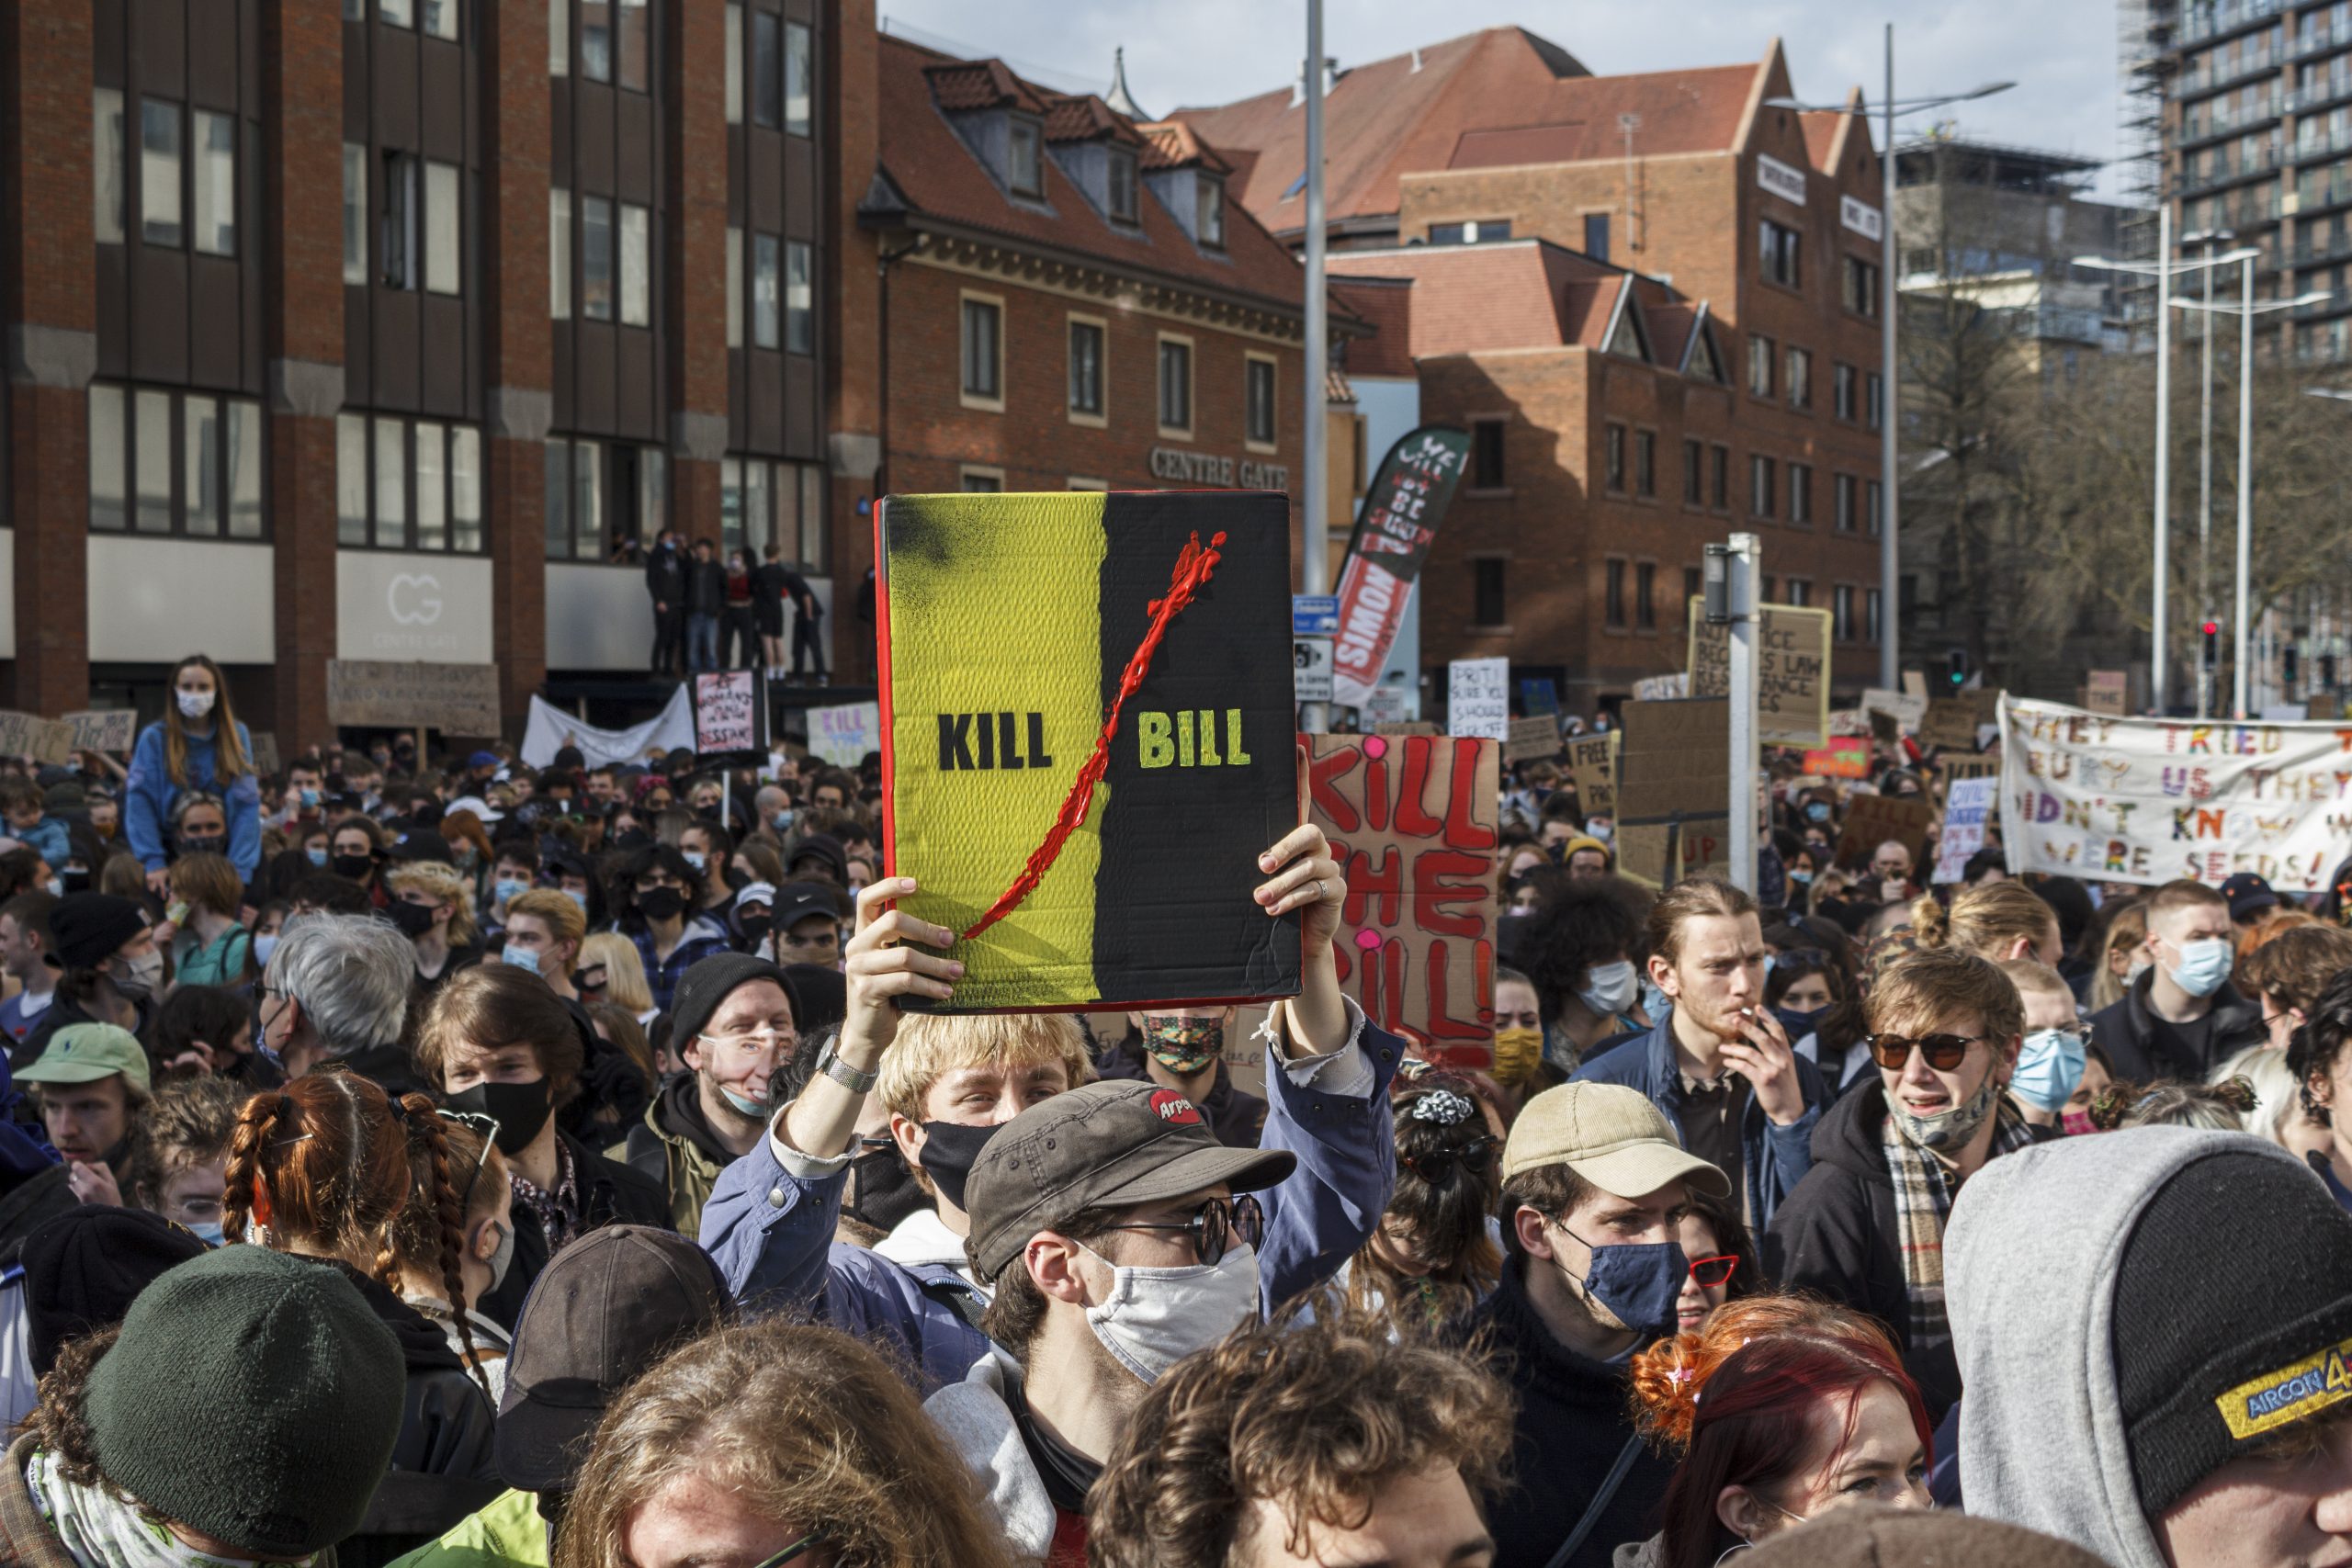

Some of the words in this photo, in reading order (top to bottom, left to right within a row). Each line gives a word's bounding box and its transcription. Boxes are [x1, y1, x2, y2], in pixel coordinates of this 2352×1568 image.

[1150, 446, 1234, 487] CENTRE
[1241, 460, 1287, 491] GATE
[1422, 435, 1457, 468] WE
[1390, 490, 1426, 521] BE
[1335, 563, 1396, 669] SIMON
[1784, 656, 1823, 677] LAW
[937, 711, 1053, 771] KILL
[1138, 709, 1251, 769] BILL
[2154, 724, 2282, 755] TRIED
[2161, 766, 2212, 799] US
[2245, 769, 2352, 803] THEY
[2015, 790, 2139, 835] IDN'T
[2043, 839, 2154, 877] WERE
[2247, 1367, 2324, 1420] AIRCON
